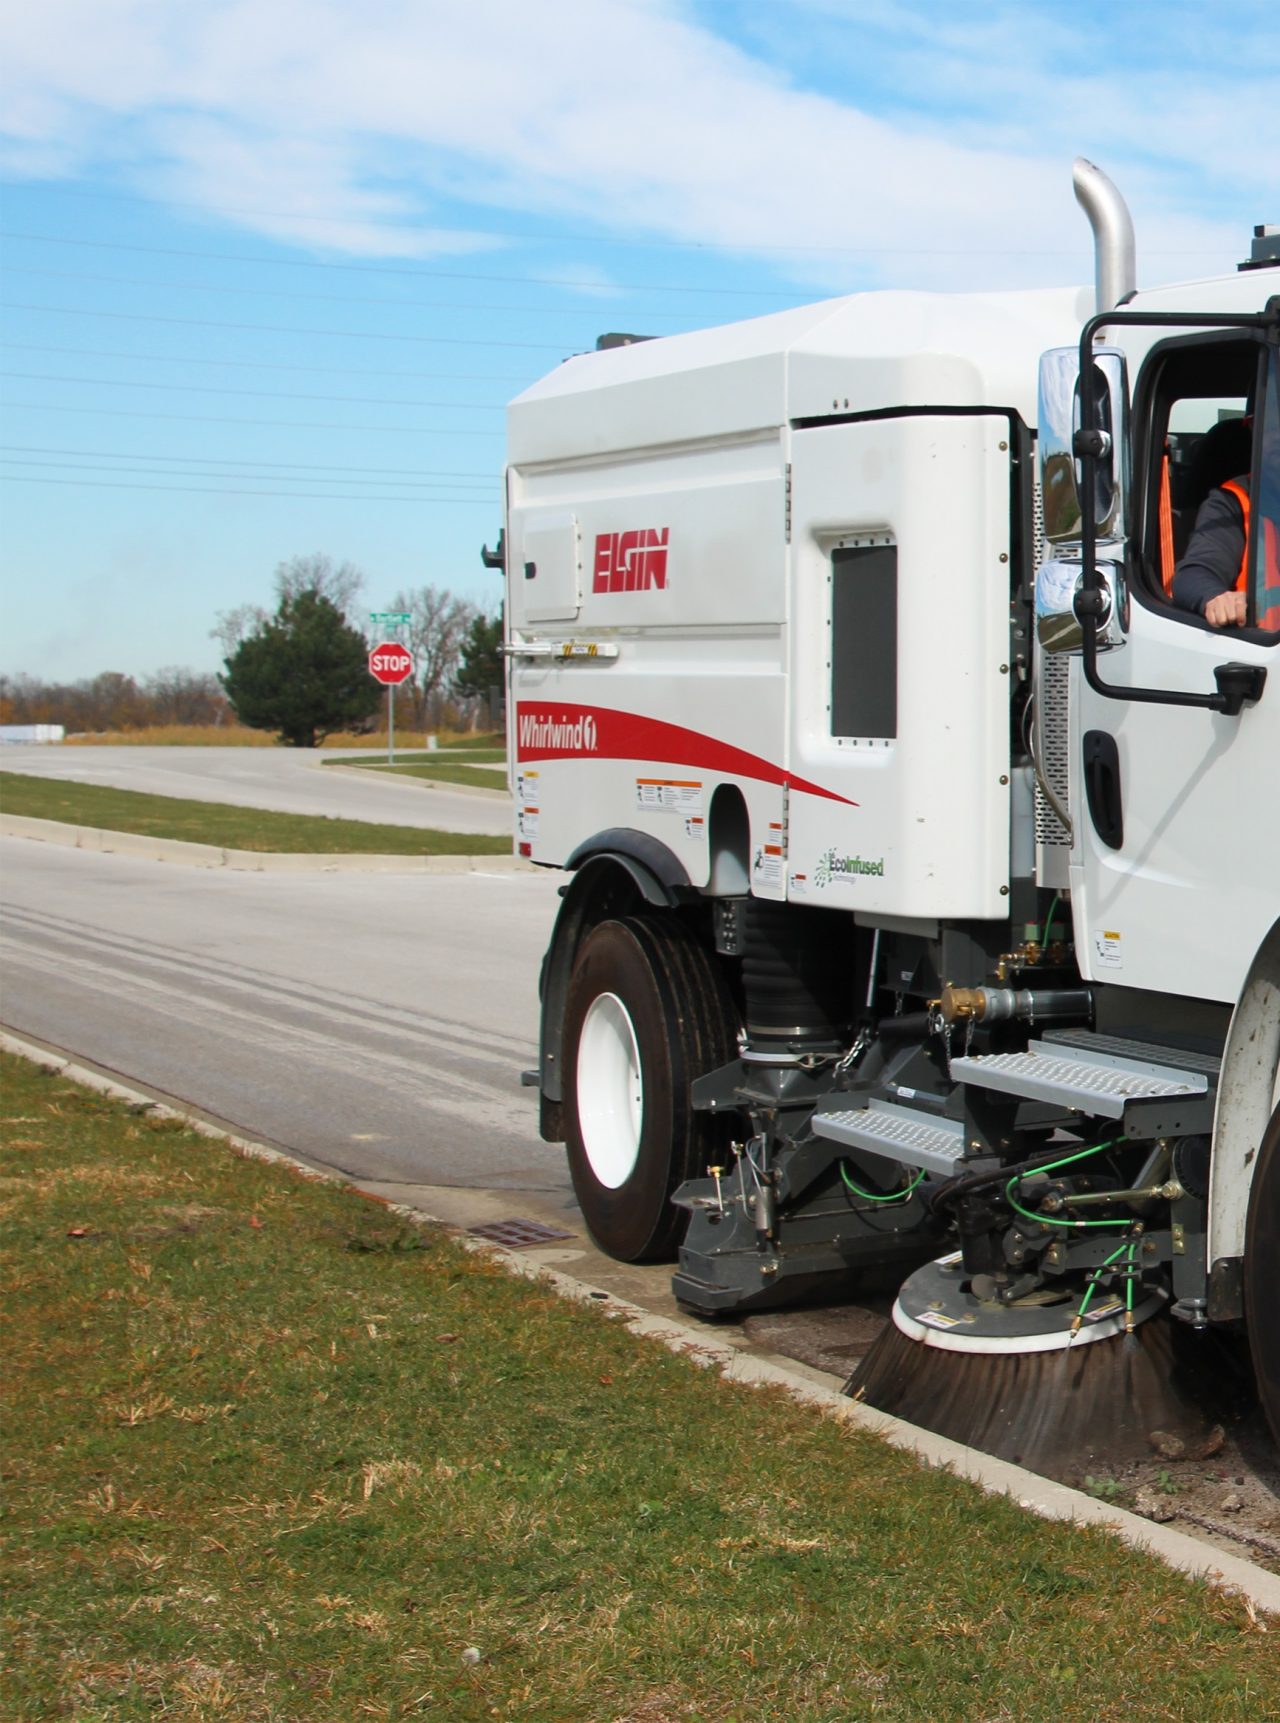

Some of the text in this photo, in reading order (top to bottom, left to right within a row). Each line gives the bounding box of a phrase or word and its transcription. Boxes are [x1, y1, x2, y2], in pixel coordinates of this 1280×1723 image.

[593, 527, 669, 594] ELGIN
[373, 655, 410, 671] STOP
[519, 715, 583, 750] Whirlwind
